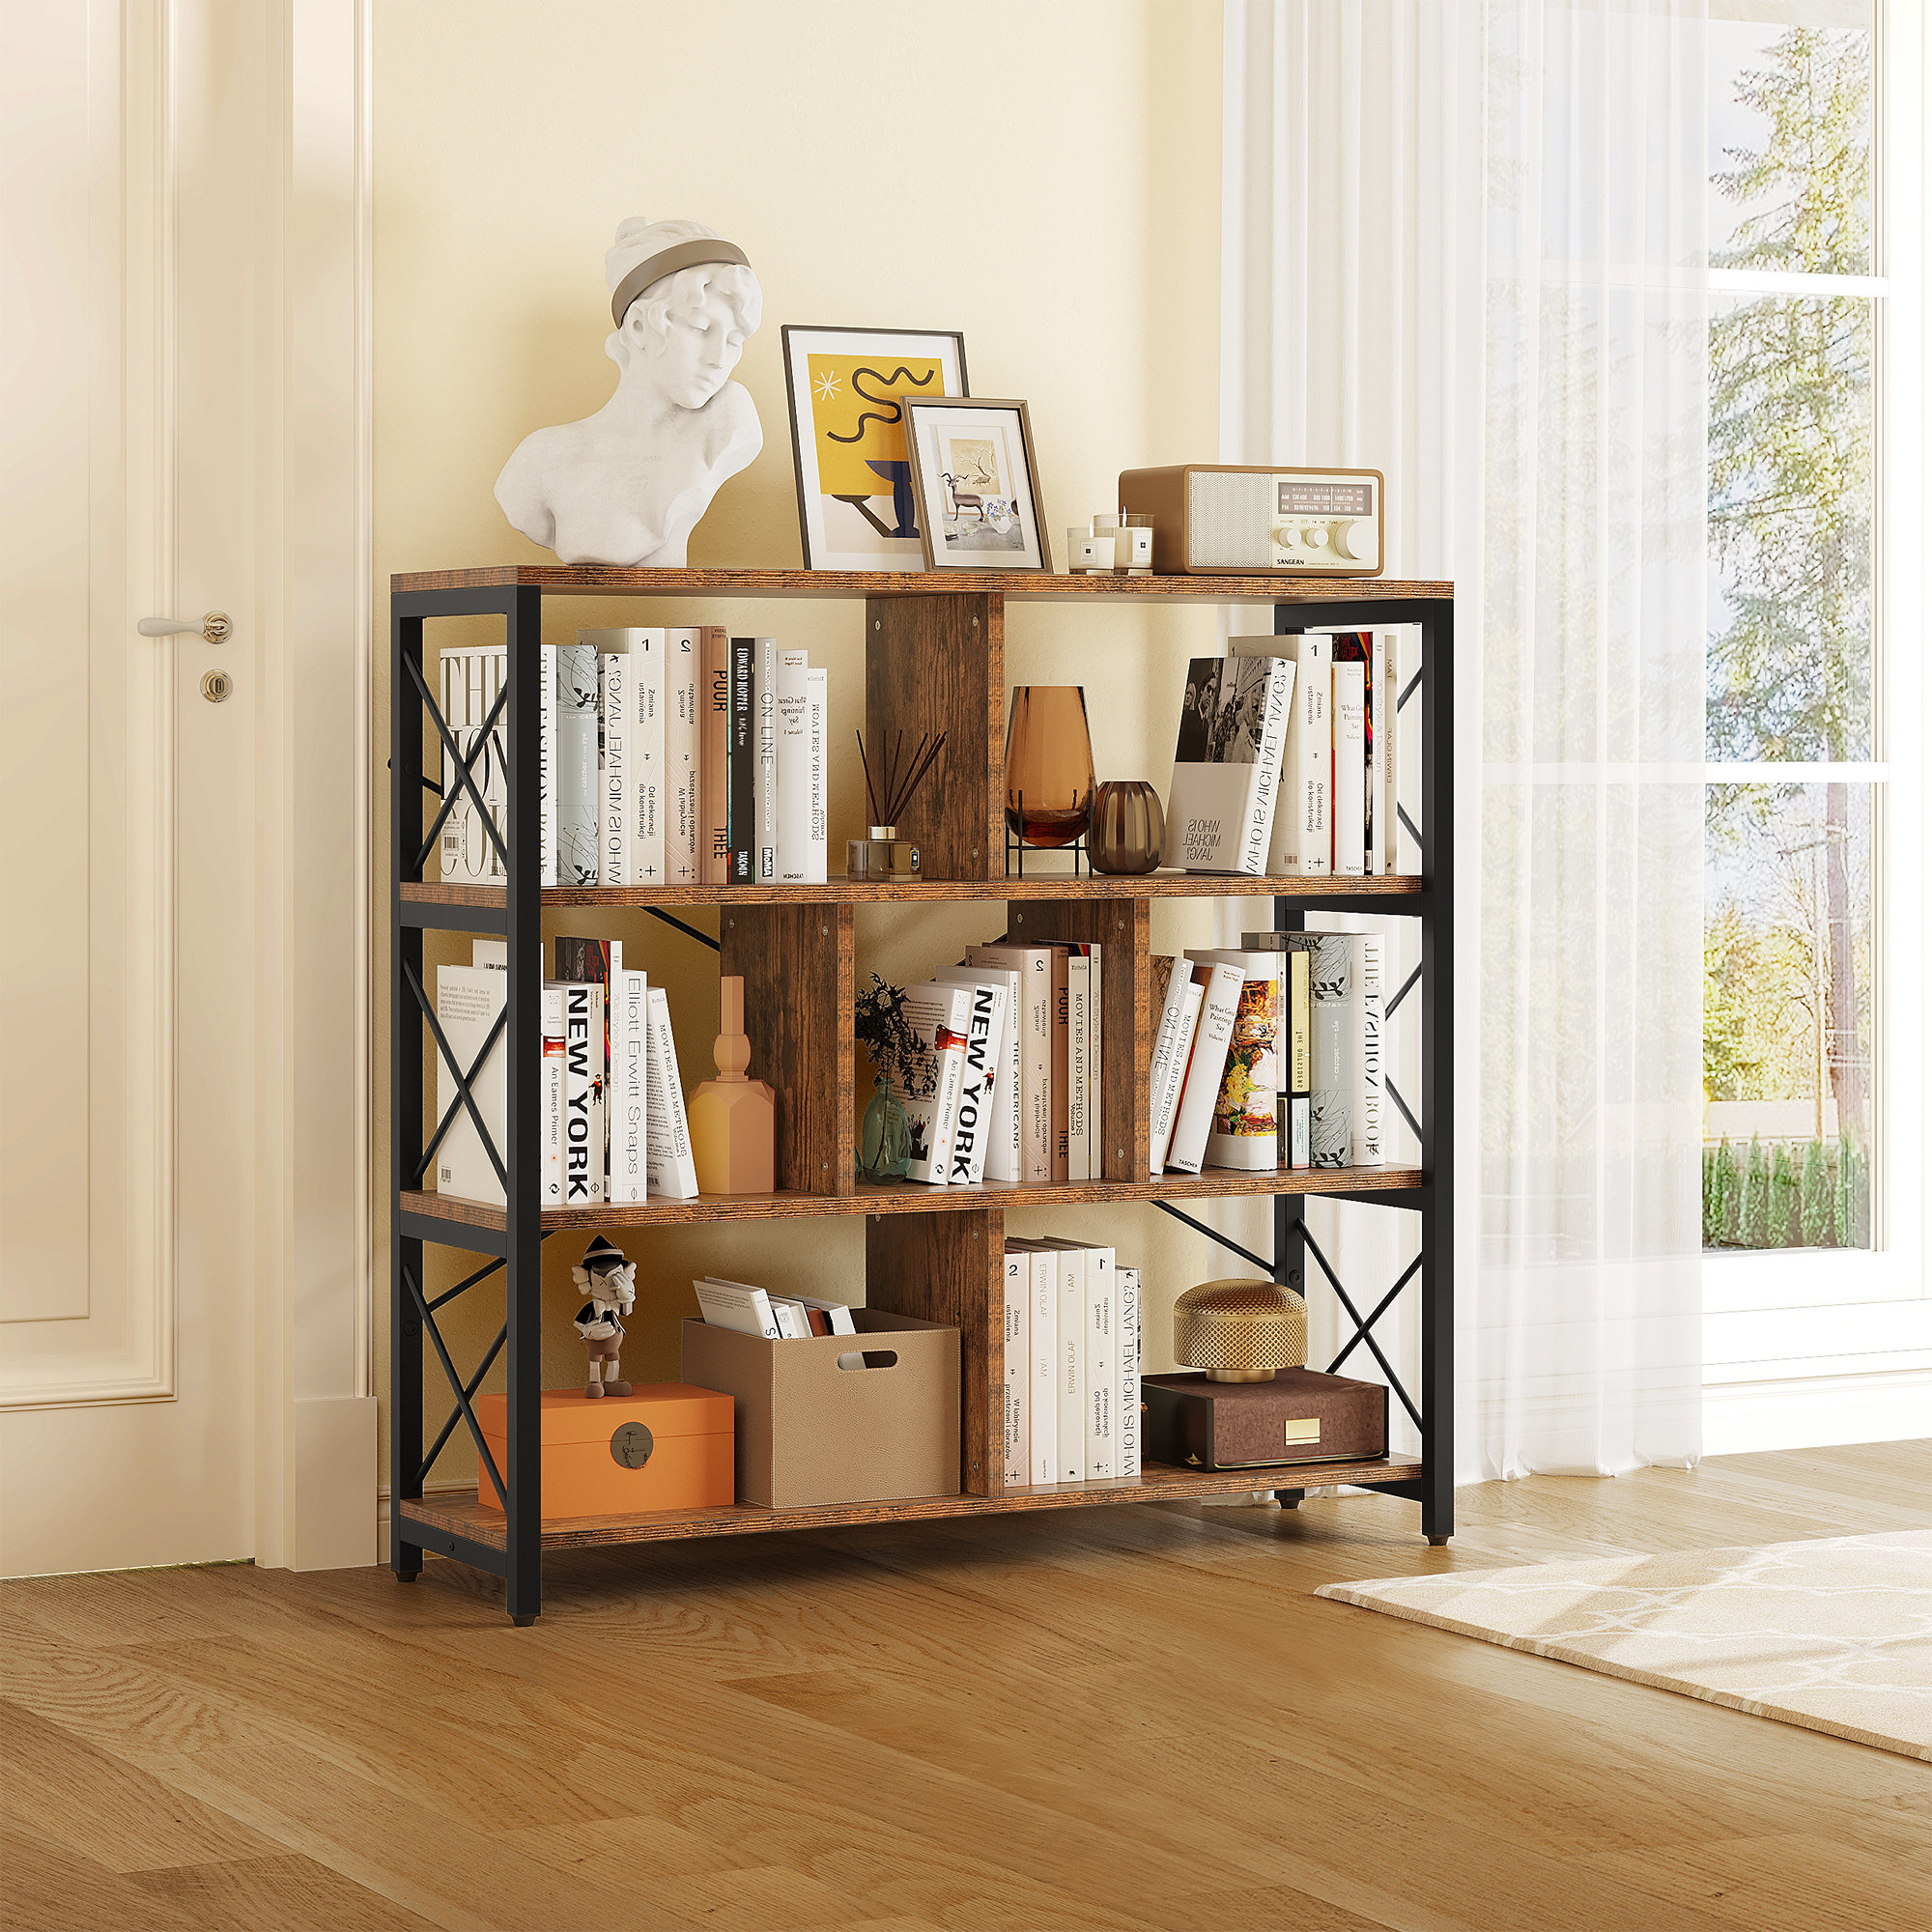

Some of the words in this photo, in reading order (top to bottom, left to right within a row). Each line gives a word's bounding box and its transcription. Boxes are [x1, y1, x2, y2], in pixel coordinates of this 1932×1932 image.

[641, 639, 650, 652] 1
[1311, 644, 1318, 657] 1
[737, 648, 749, 681] EDWARD
[737, 682, 749, 711] HOPPER
[761, 693, 773, 717] ON
[761, 725, 773, 765] LINE
[639, 783, 646, 793] do
[648, 786, 655, 798] Od
[1307, 781, 1314, 791] do
[1317, 782, 1324, 794] Od
[638, 796, 646, 840] konstrukcji
[647, 799, 655, 837] dekoracji
[1316, 796, 1324, 831] dekoracji
[714, 828, 727, 859] THEE
[738, 851, 749, 876] TASCHEN
[763, 848, 772, 877] MoMA
[628, 978, 641, 1032] Elliott
[1209, 1003, 1225, 1014] What
[568, 990, 588, 1078] NEW
[967, 989, 994, 1070] NEW
[1215, 1024, 1225, 1033] Say
[613, 1041, 620, 1050] &
[551, 1067, 559, 1080] An
[628, 1040, 641, 1098] Erwitt
[951, 1059, 958, 1071] An
[659, 1024, 673, 1072] MOVIES
[668, 1074, 677, 1099] AND
[673, 1101, 687, 1157] METHODS
[947, 1073, 957, 1100] Eames
[943, 1103, 952, 1130] Primer
[952, 1082, 982, 1179] YORK
[568, 1093, 588, 1199] YORK
[626, 1106, 641, 1175] Snaps
[1059, 1130, 1068, 1159] THEE
[1009, 1264, 1018, 1276] 2
[1068, 1273, 1075, 1289] AM
[1123, 1285, 1135, 1336] JANG?
[1039, 1363, 1047, 1378] AM
[1123, 1338, 1135, 1411] MICHAEL
[1014, 1398, 1020, 1406] W
[1123, 1415, 1135, 1430] IS
[1123, 1434, 1135, 1476] WHO
